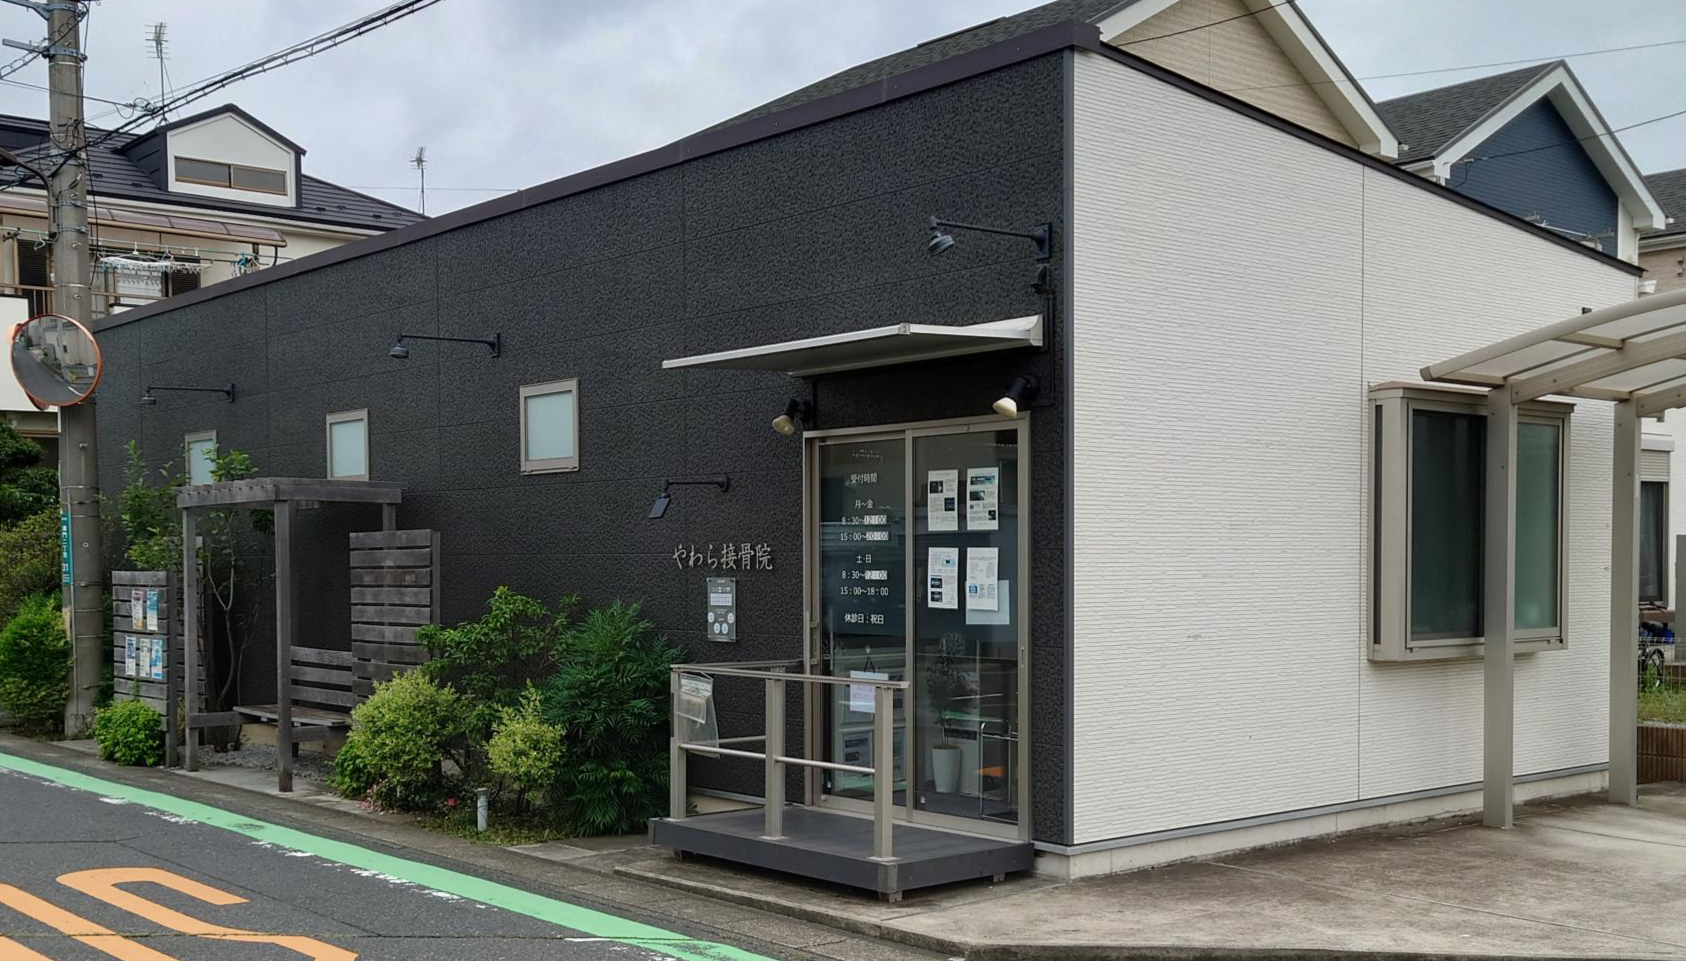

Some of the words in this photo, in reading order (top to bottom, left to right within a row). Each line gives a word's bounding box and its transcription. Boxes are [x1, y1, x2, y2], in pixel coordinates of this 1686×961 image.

[850, 472, 878, 484] 受付時間
[672, 542, 773, 570] やわら接骨院
[844, 612, 884, 625] 休診日：祝日
